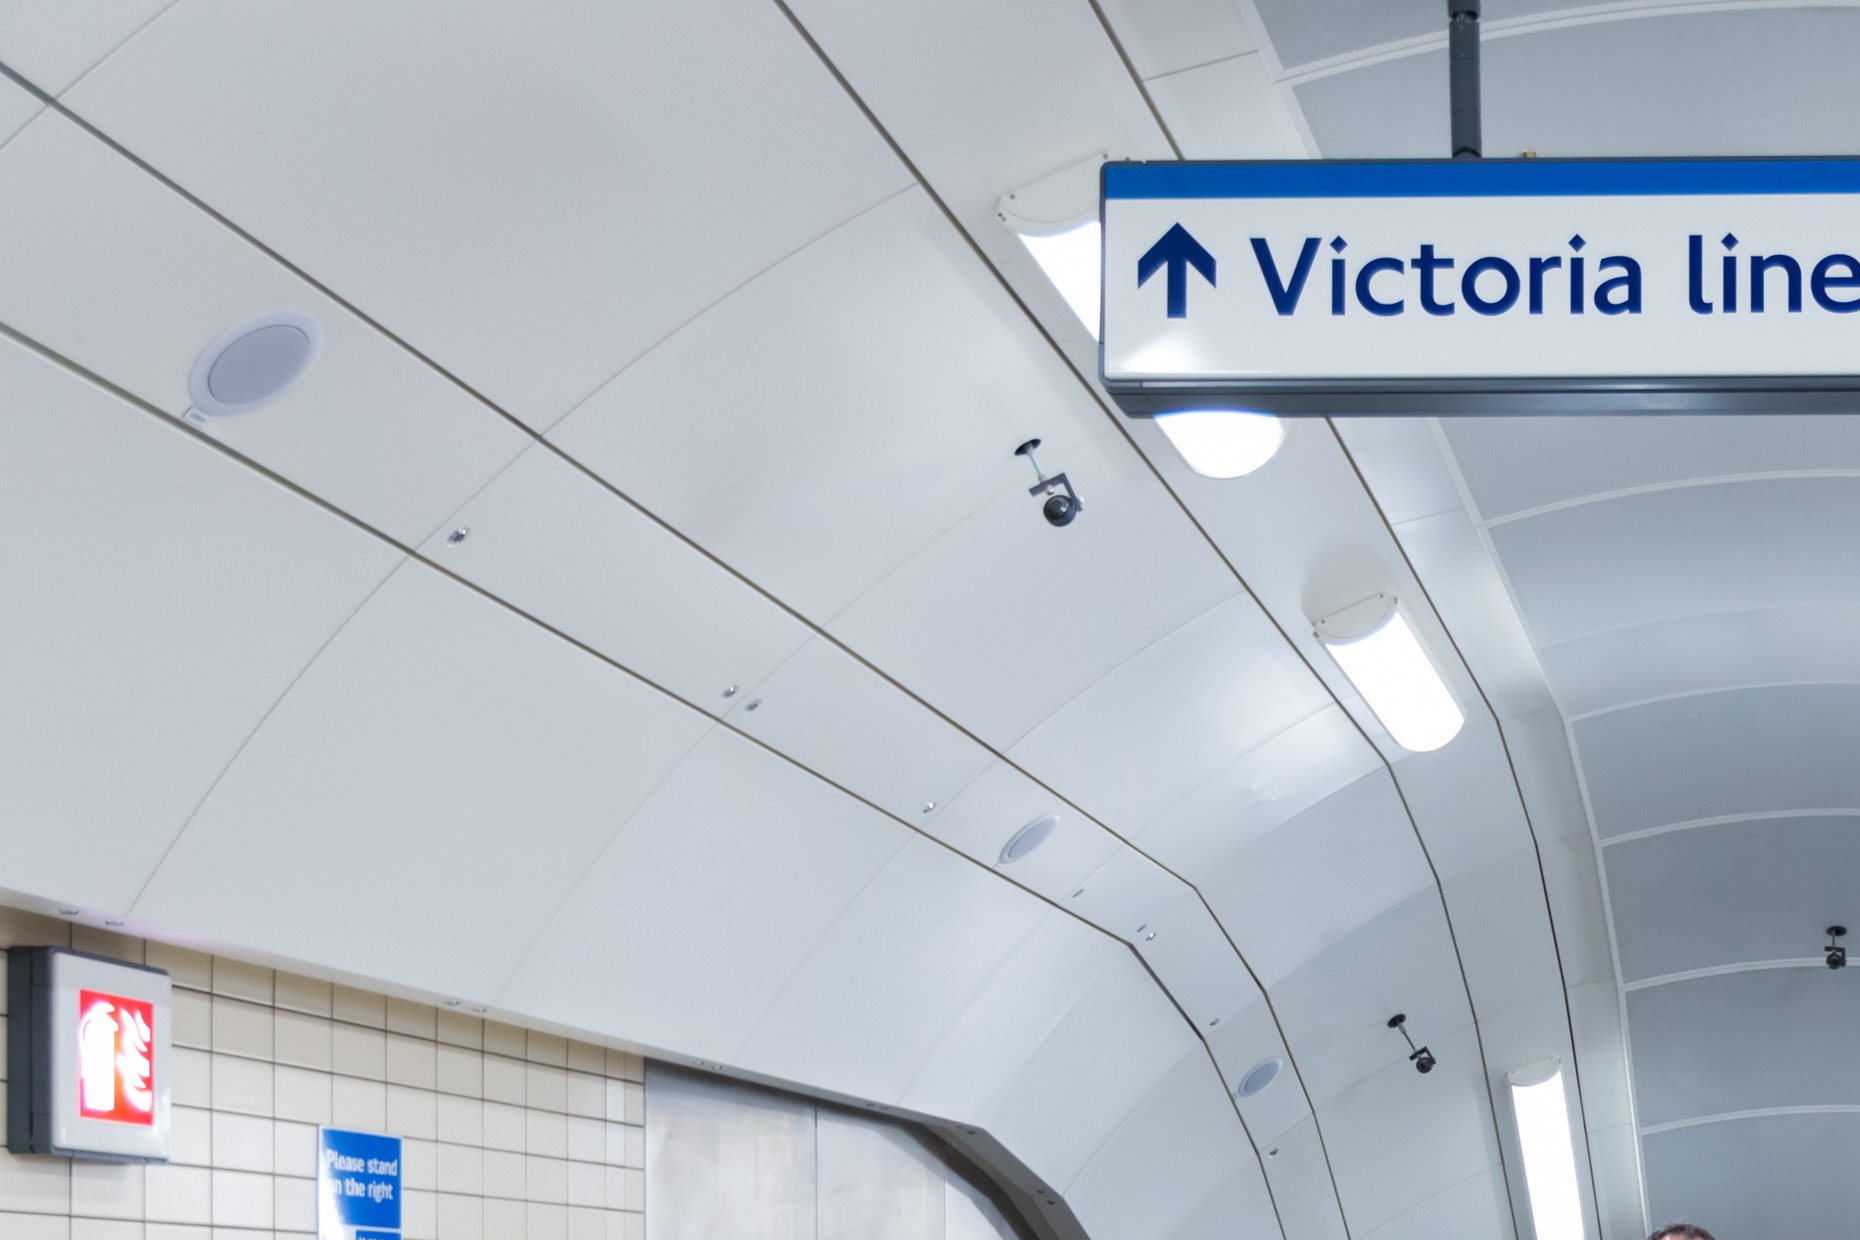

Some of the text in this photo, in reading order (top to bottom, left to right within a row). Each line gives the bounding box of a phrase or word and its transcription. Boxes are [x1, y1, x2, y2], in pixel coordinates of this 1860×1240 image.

[1250, 233, 1642, 317] Victoria
[327, 1148, 398, 1176] Please stand
[345, 1177, 365, 1197] the
[367, 1180, 394, 1204] right
